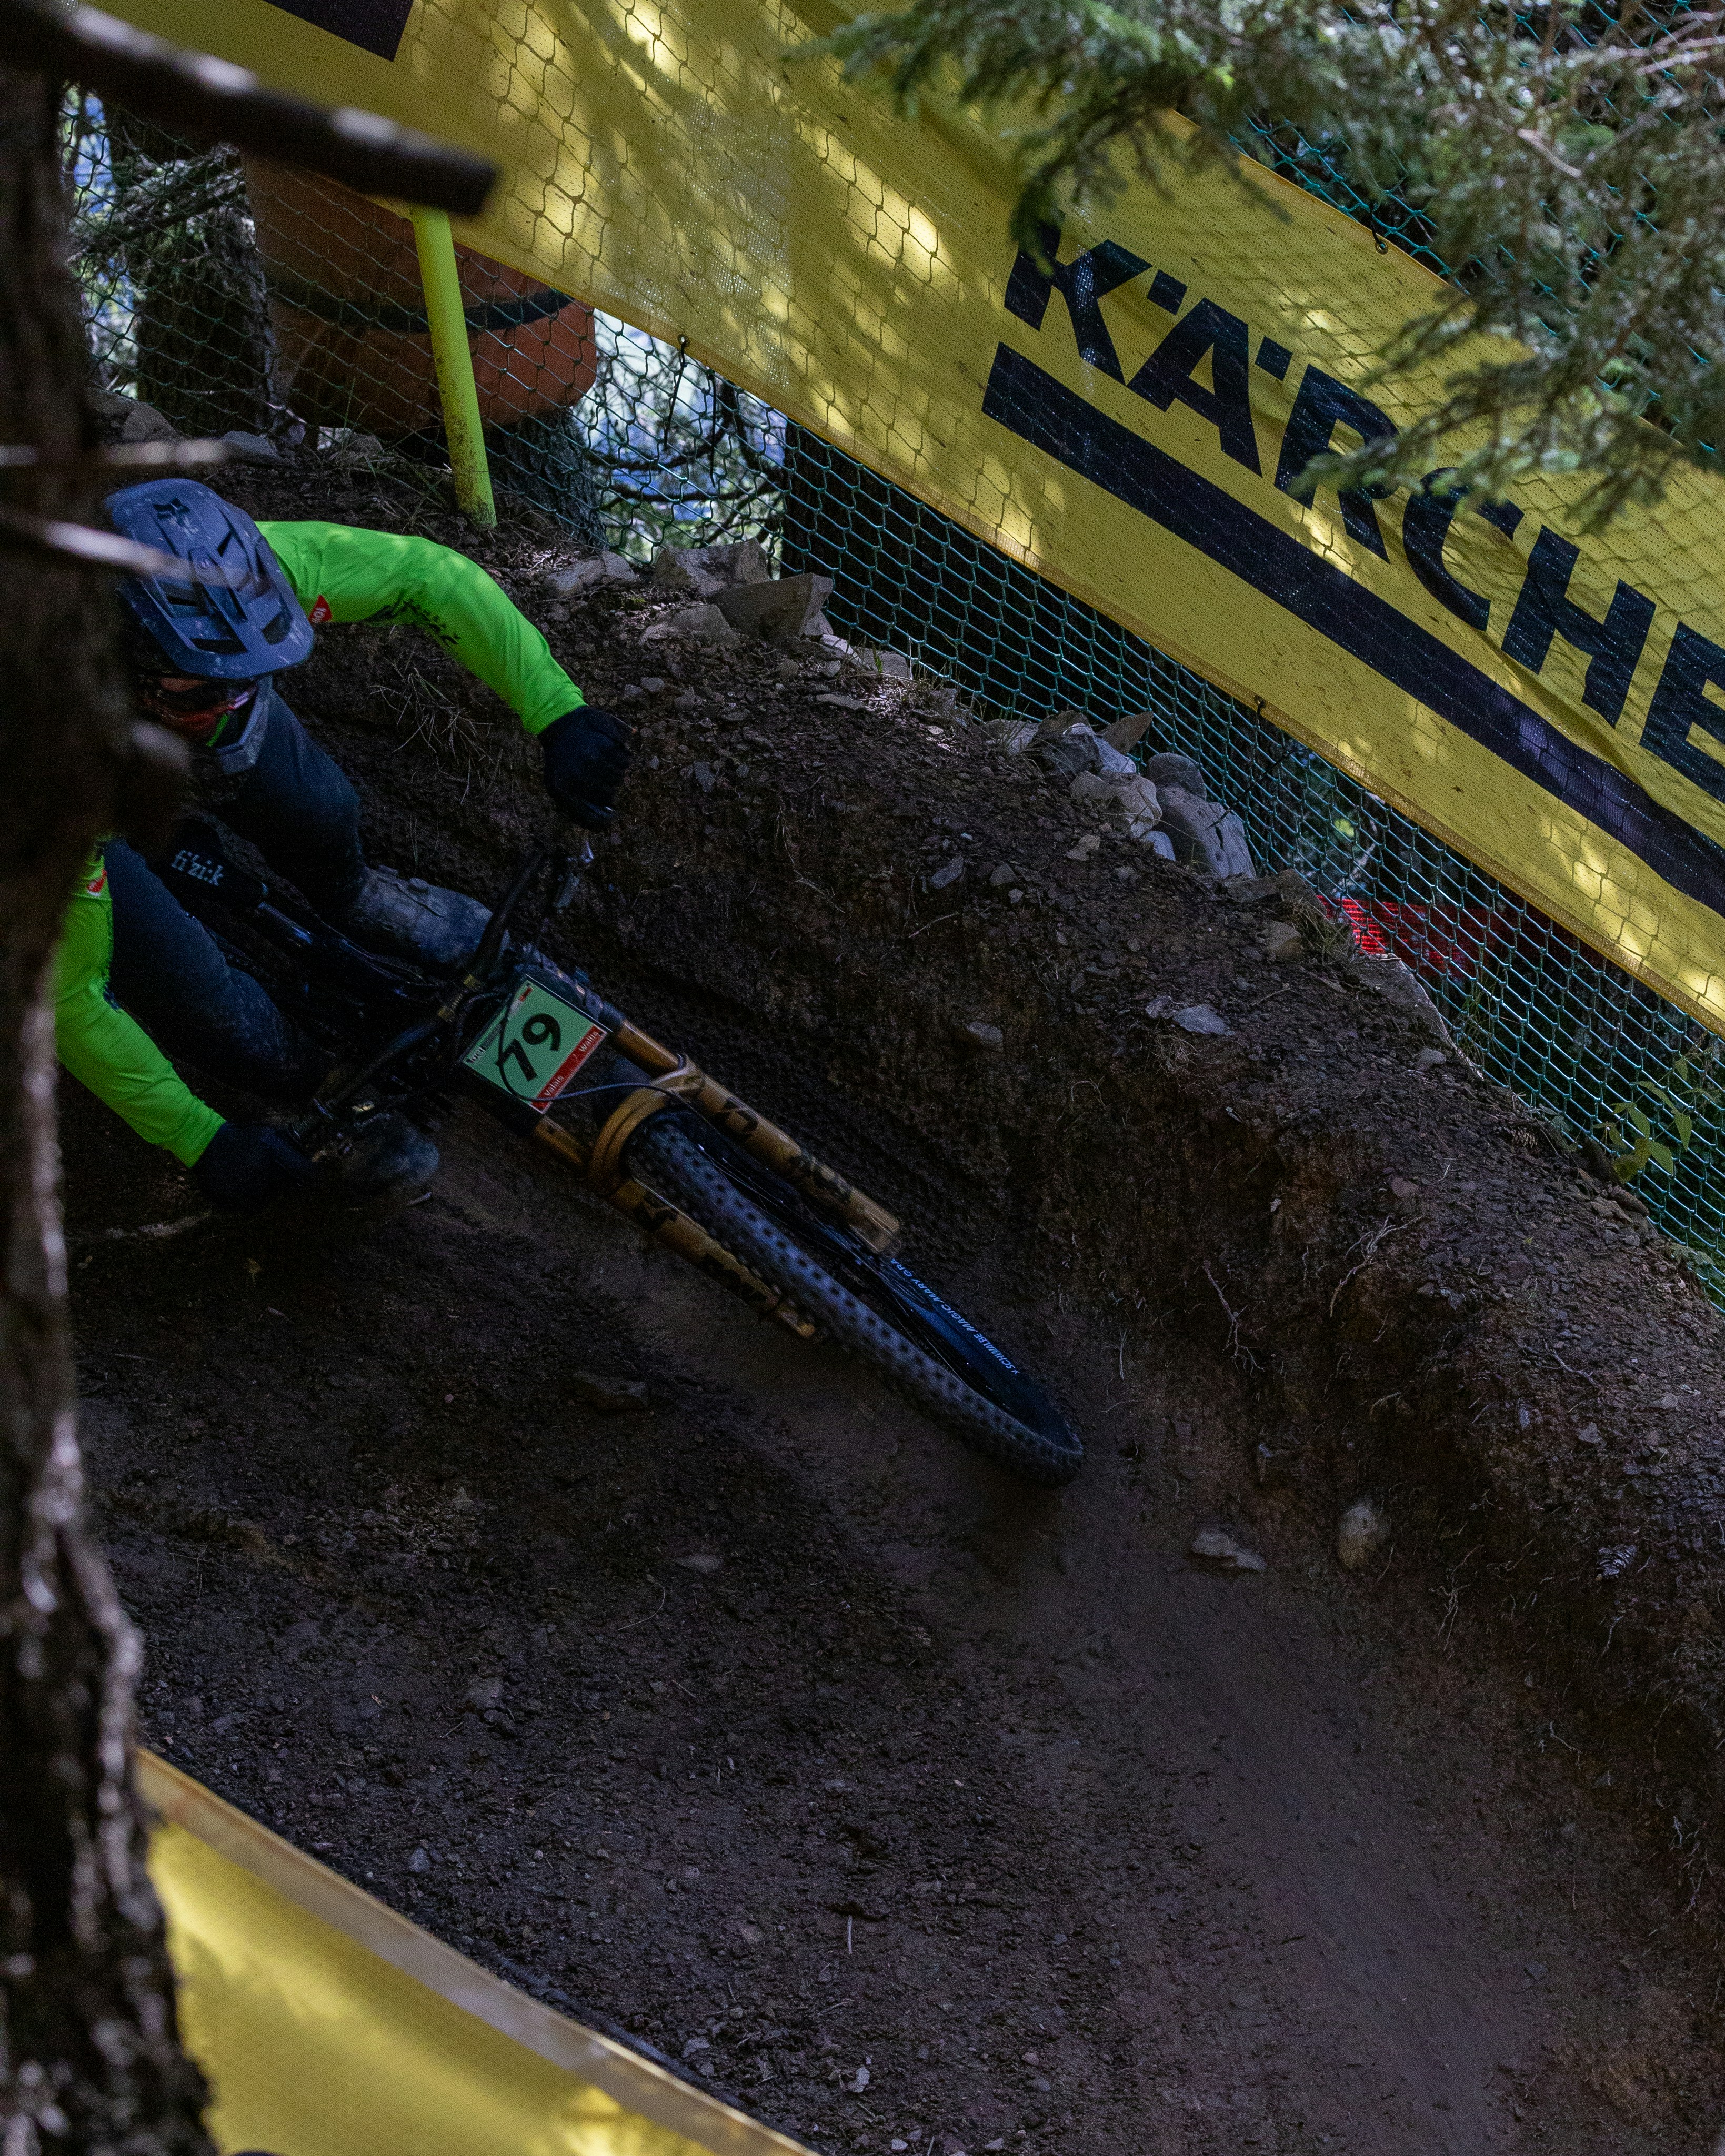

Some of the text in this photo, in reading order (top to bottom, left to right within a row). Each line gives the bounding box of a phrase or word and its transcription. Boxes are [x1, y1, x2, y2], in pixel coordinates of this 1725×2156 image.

[496, 1013, 561, 1082] 79
[543, 1031, 600, 1097] Valais Wallis
[910, 1278, 945, 1304] MARY
[940, 1303, 979, 1333] MAGIC
[973, 1332, 1016, 1370] SCHWALBE
